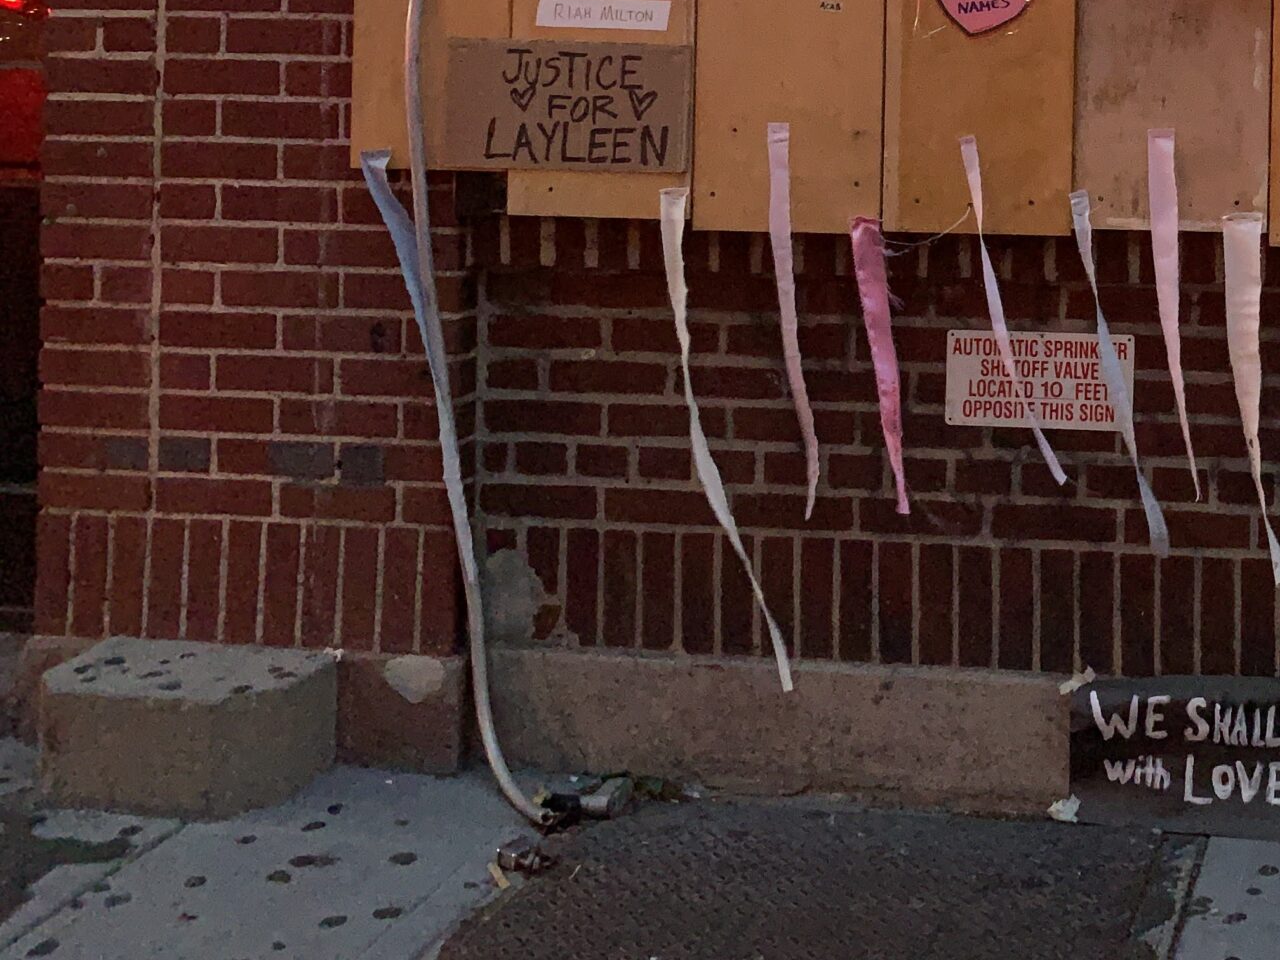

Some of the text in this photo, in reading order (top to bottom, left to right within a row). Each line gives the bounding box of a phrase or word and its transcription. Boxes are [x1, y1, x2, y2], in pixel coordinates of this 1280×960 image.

[553, 3, 655, 23] RIAH MILTON
[502, 48, 644, 91] JUSTICE
[548, 94, 619, 124] FOR
[483, 116, 670, 167] LAYLEEN
[1043, 340, 1128, 360] SPRINKR
[1053, 361, 1099, 381] VALVE
[1040, 381, 1064, 398] 10
[1040, 401, 1074, 422] THIS
[1079, 402, 1116, 423] SIGN
[1088, 690, 1173, 741] WE
[1103, 754, 1171, 790] with
